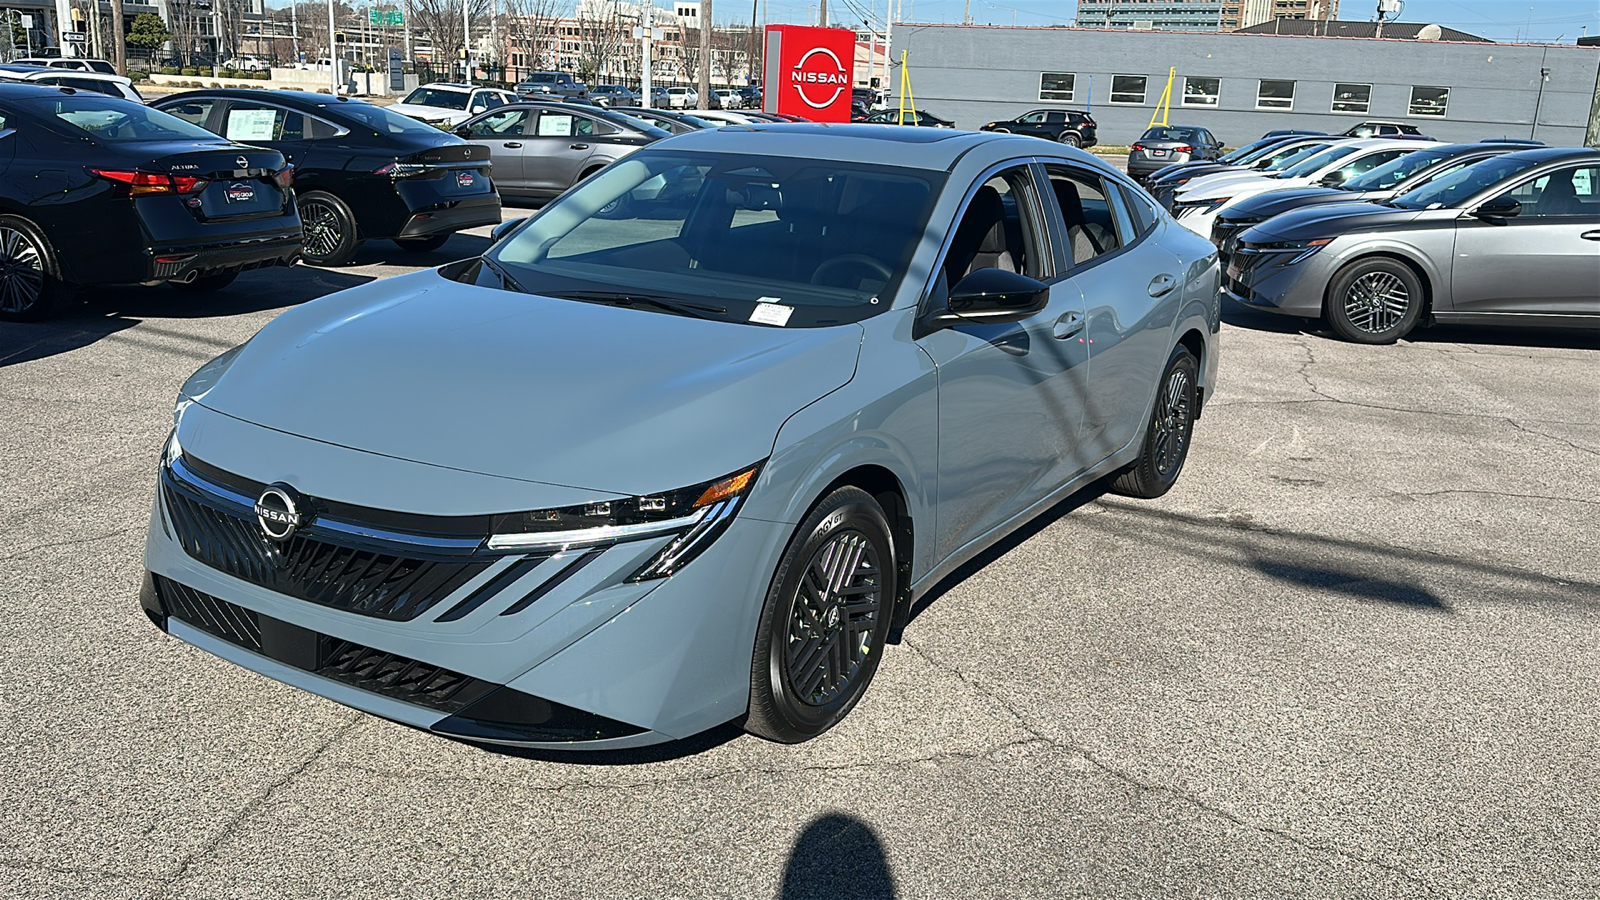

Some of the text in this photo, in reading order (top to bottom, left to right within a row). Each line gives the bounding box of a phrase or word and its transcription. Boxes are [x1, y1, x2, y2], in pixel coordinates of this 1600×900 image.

[792, 71, 847, 84] NISSAN
[254, 504, 298, 524] NISSAN
[834, 513, 843, 524] GT
